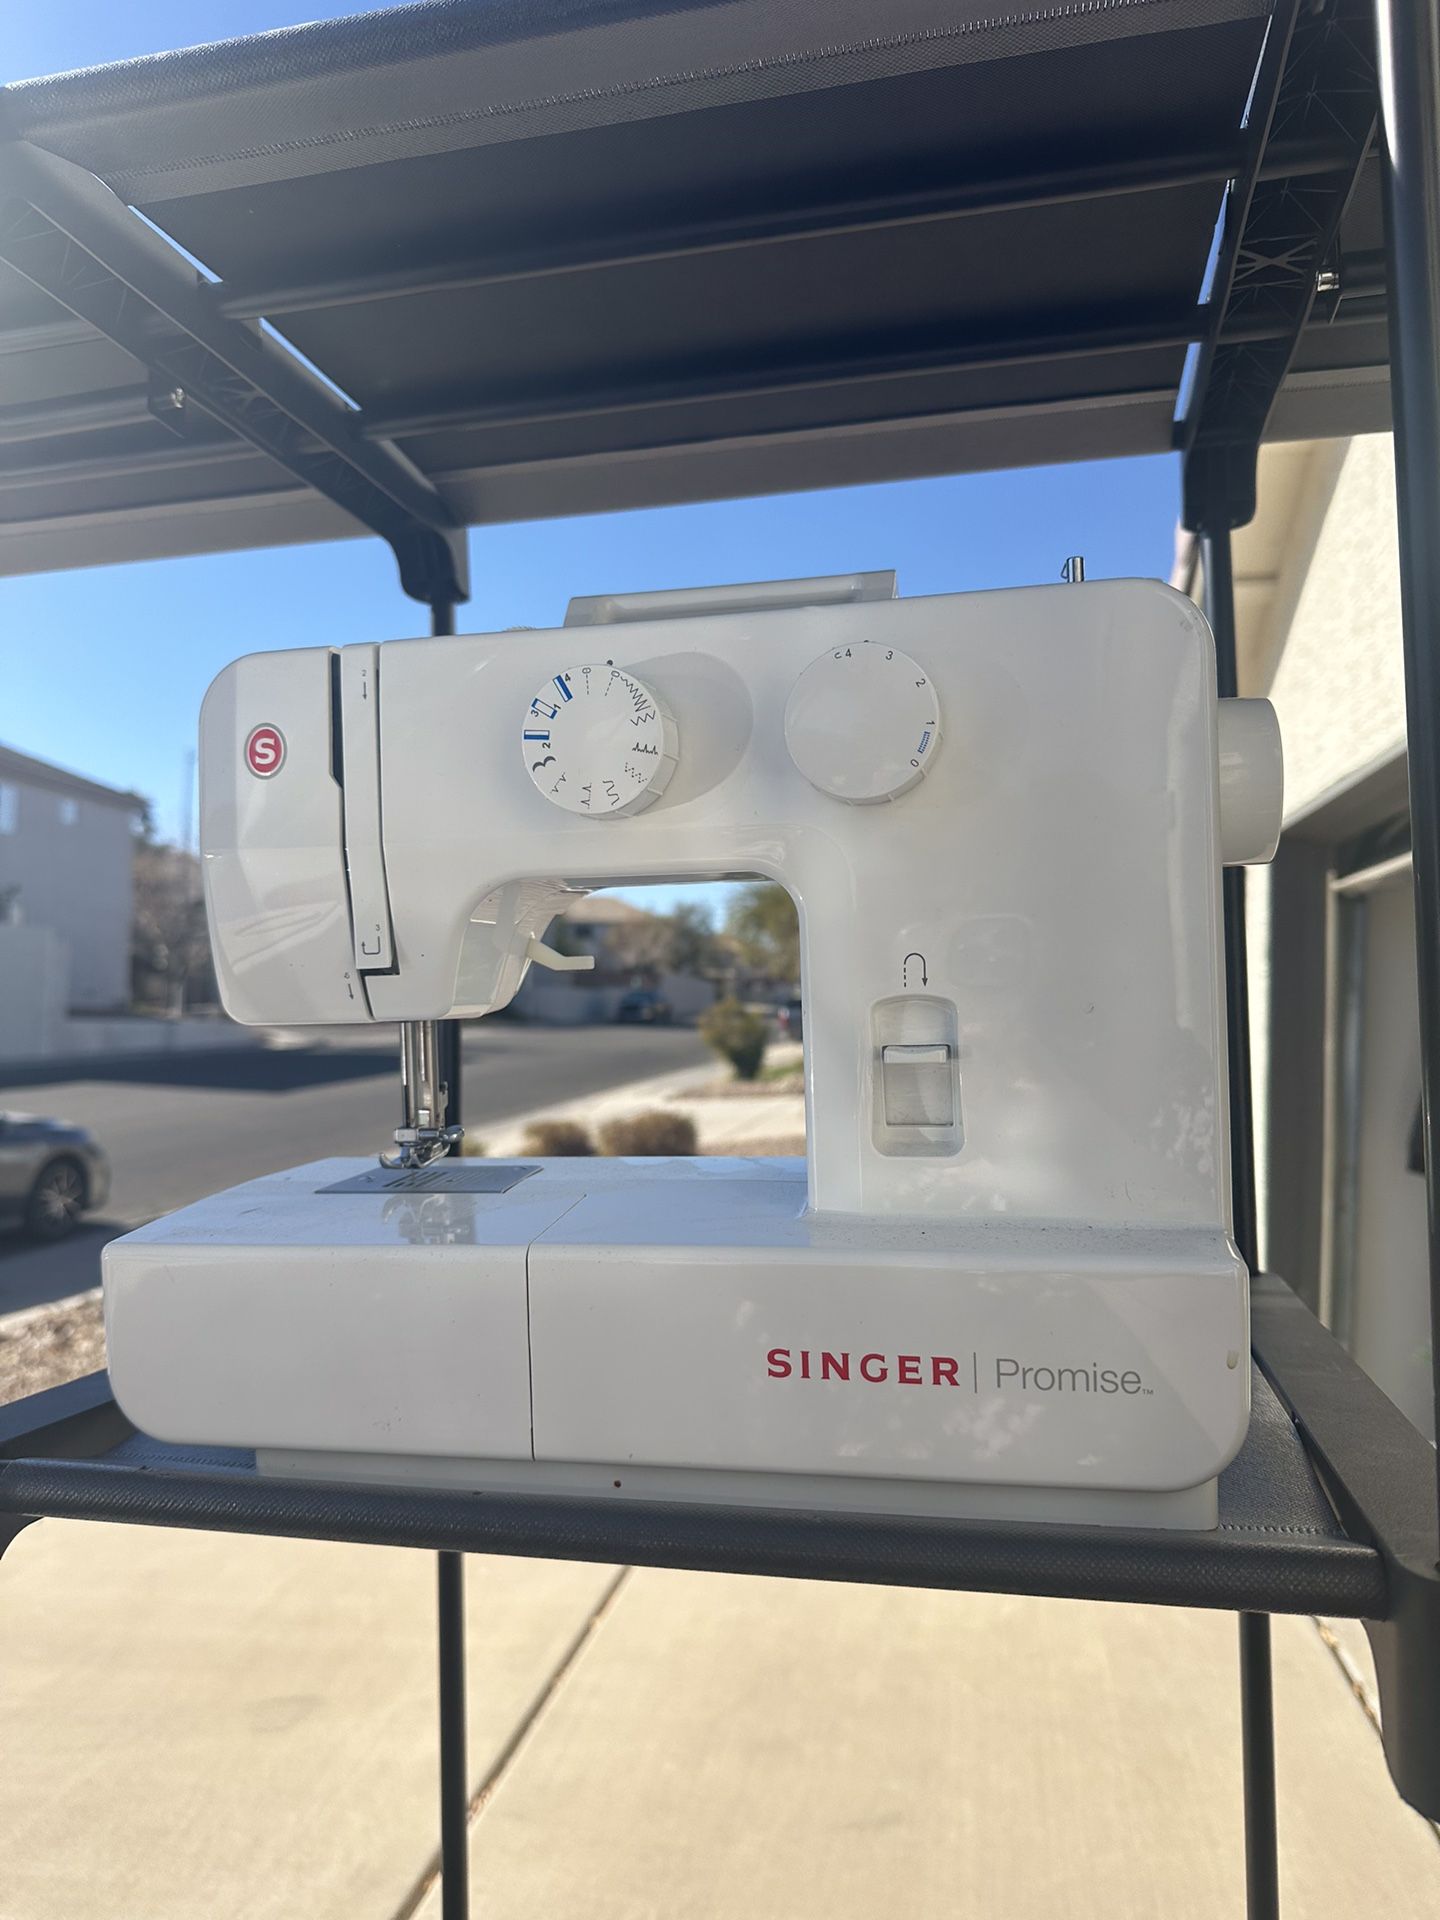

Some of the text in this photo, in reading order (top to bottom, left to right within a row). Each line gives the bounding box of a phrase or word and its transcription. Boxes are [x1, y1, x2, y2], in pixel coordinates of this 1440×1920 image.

[845, 648, 852, 658] 4
[885, 650, 894, 661] 3
[564, 673, 571, 682] 4
[915, 678, 926, 688] 2
[530, 709, 540, 718] 3
[910, 758, 920, 768] 0
[767, 1348, 960, 1386] SINGER
[996, 1358, 1142, 1395] Promise
